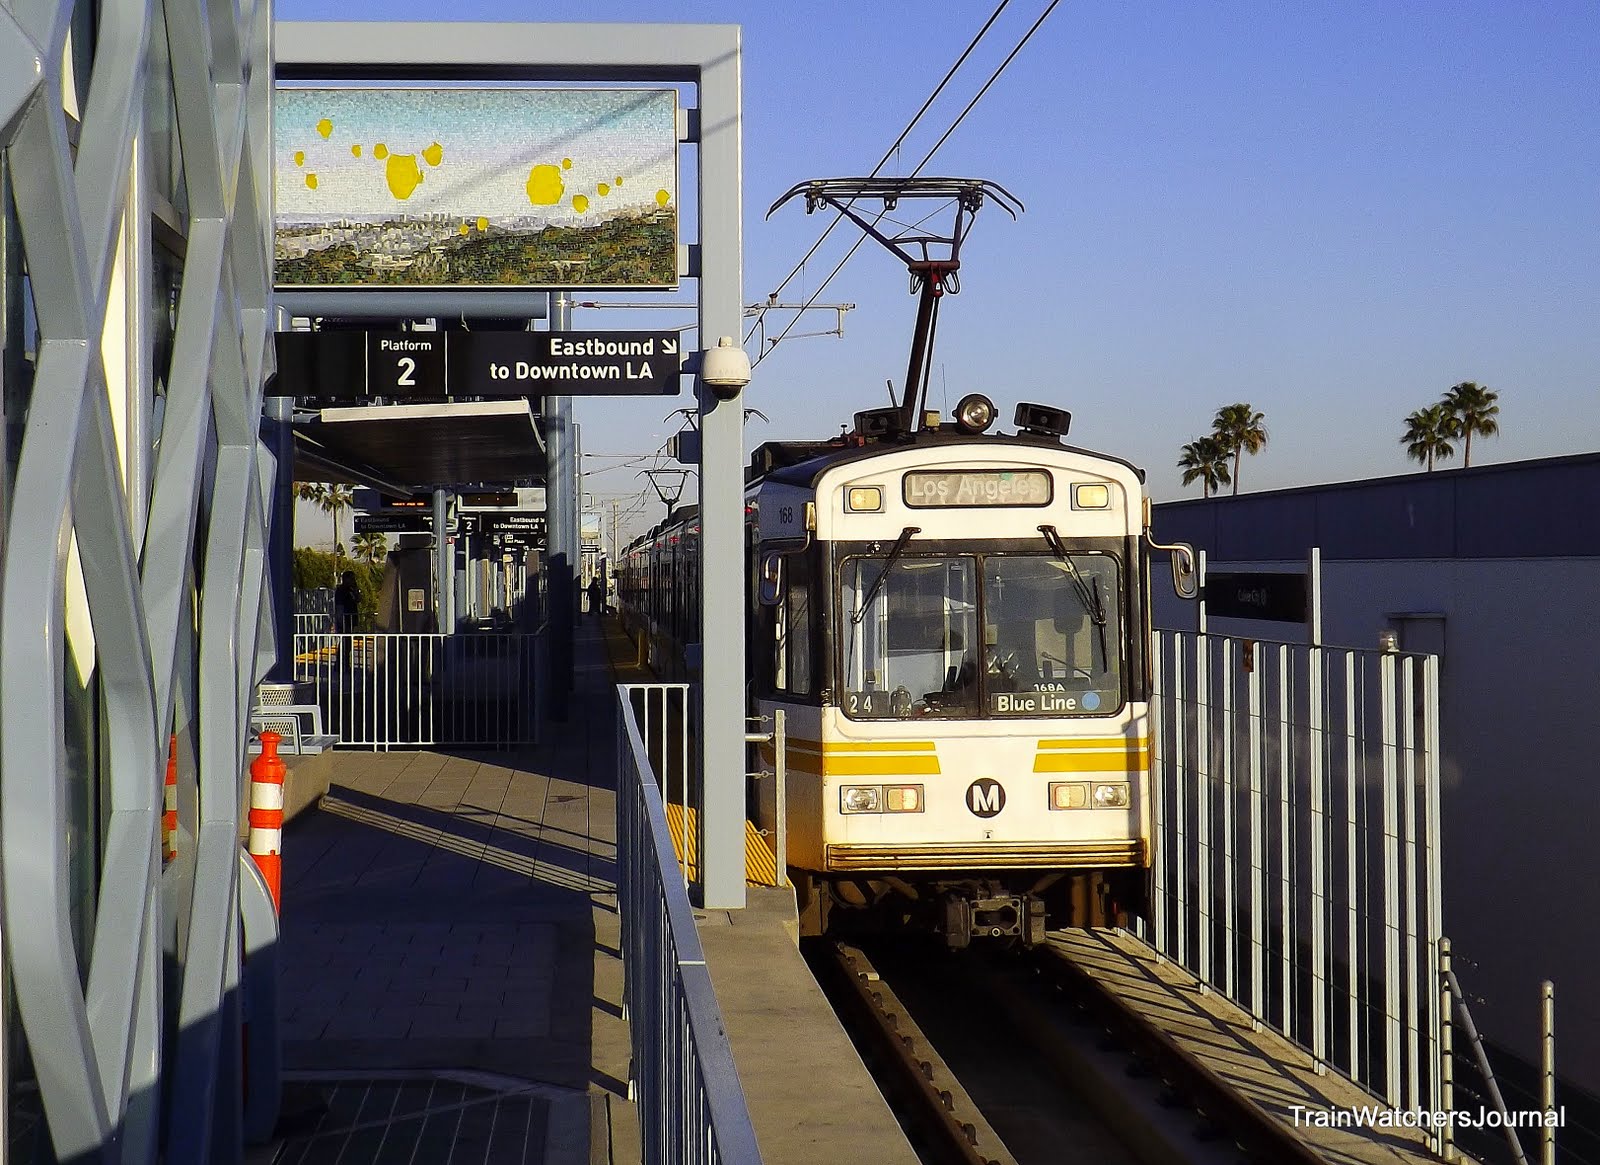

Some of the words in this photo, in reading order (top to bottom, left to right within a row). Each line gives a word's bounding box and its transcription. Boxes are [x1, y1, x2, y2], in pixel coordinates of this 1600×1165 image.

[380, 339, 432, 352] Platform
[550, 338, 654, 356] Eastbound
[397, 358, 416, 386] 2
[490, 364, 510, 379] to
[515, 362, 620, 379] Downtown
[626, 361, 653, 379] LA
[911, 475, 949, 496] Los
[956, 474, 1041, 500] Angeles
[779, 506, 793, 524] 168
[466, 521, 472, 530] 2
[1033, 683, 1066, 692] 168A
[997, 695, 1036, 712] Blue
[1041, 695, 1076, 711] Line
